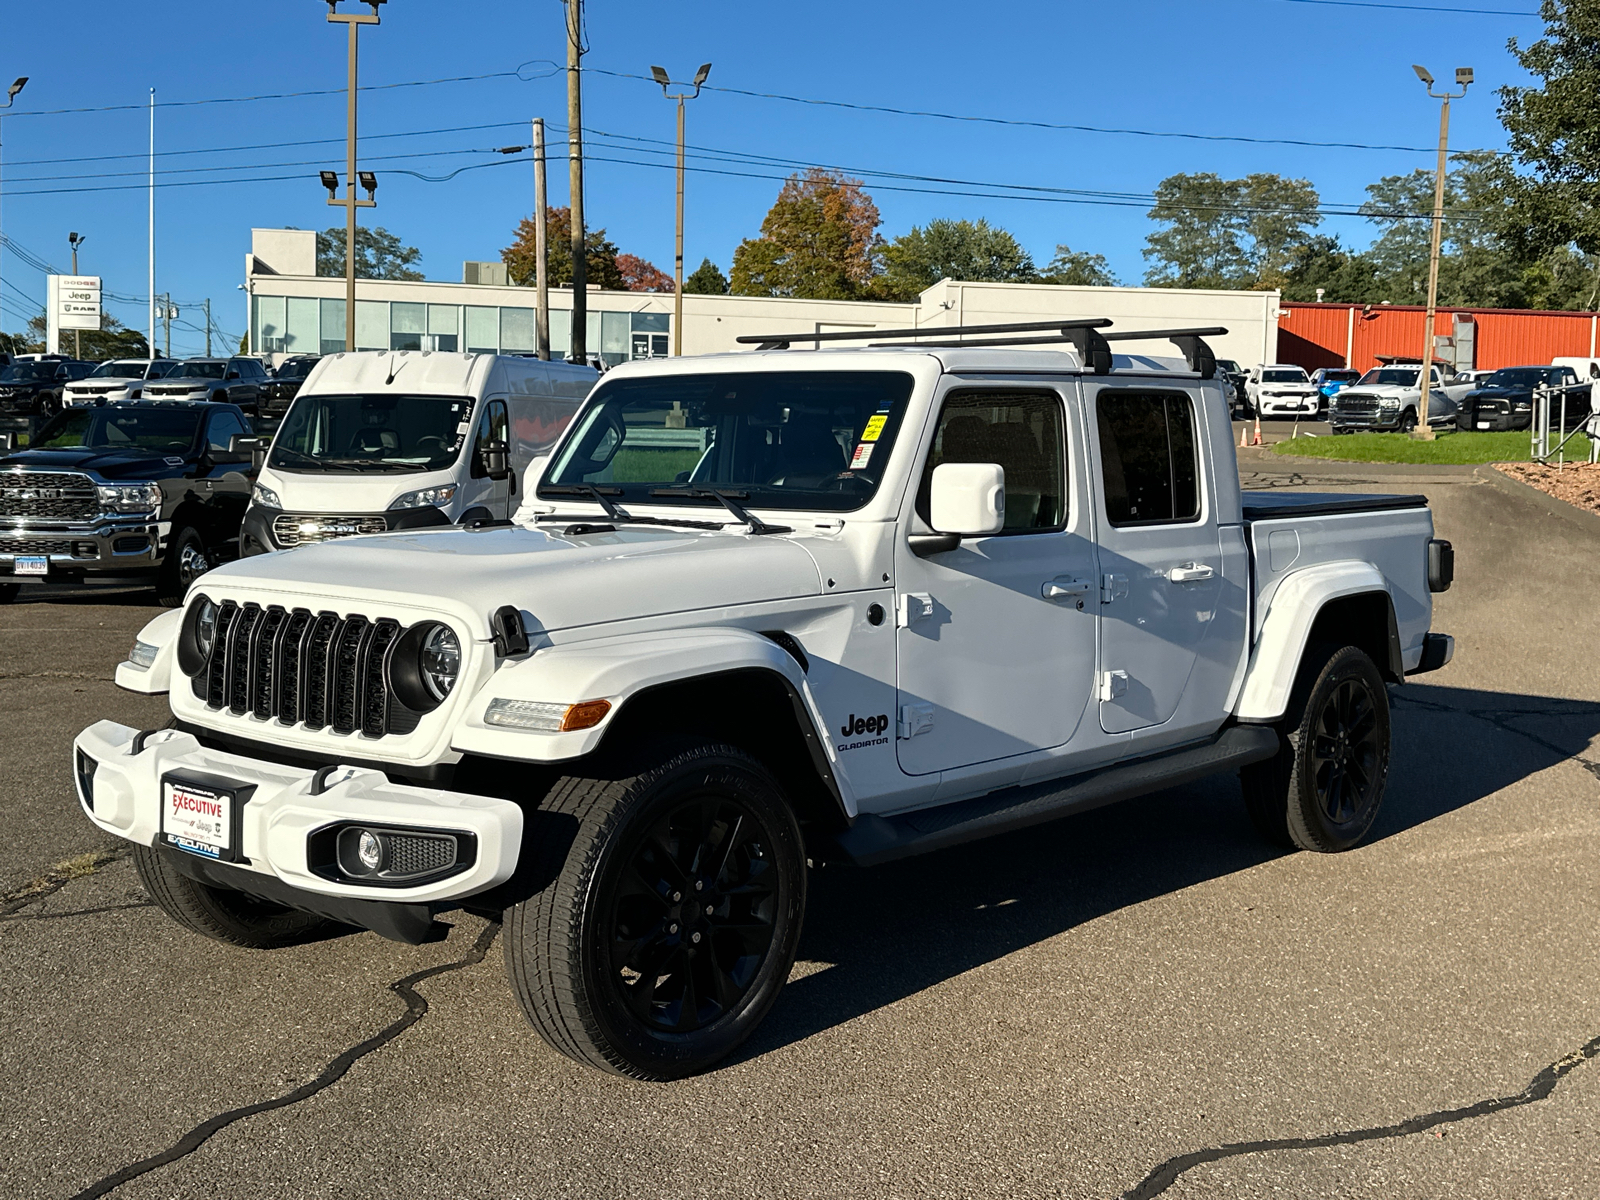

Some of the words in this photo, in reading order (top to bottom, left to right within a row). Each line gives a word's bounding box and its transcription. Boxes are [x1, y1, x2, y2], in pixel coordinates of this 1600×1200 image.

[68, 291, 91, 300] Jeep
[300, 524, 355, 532] AM
[841, 713, 889, 738] Jeep
[837, 737, 889, 752] GLADIATOR
[172, 791, 222, 818] EXECUTIVE
[167, 834, 220, 855] EXECUTIVE
